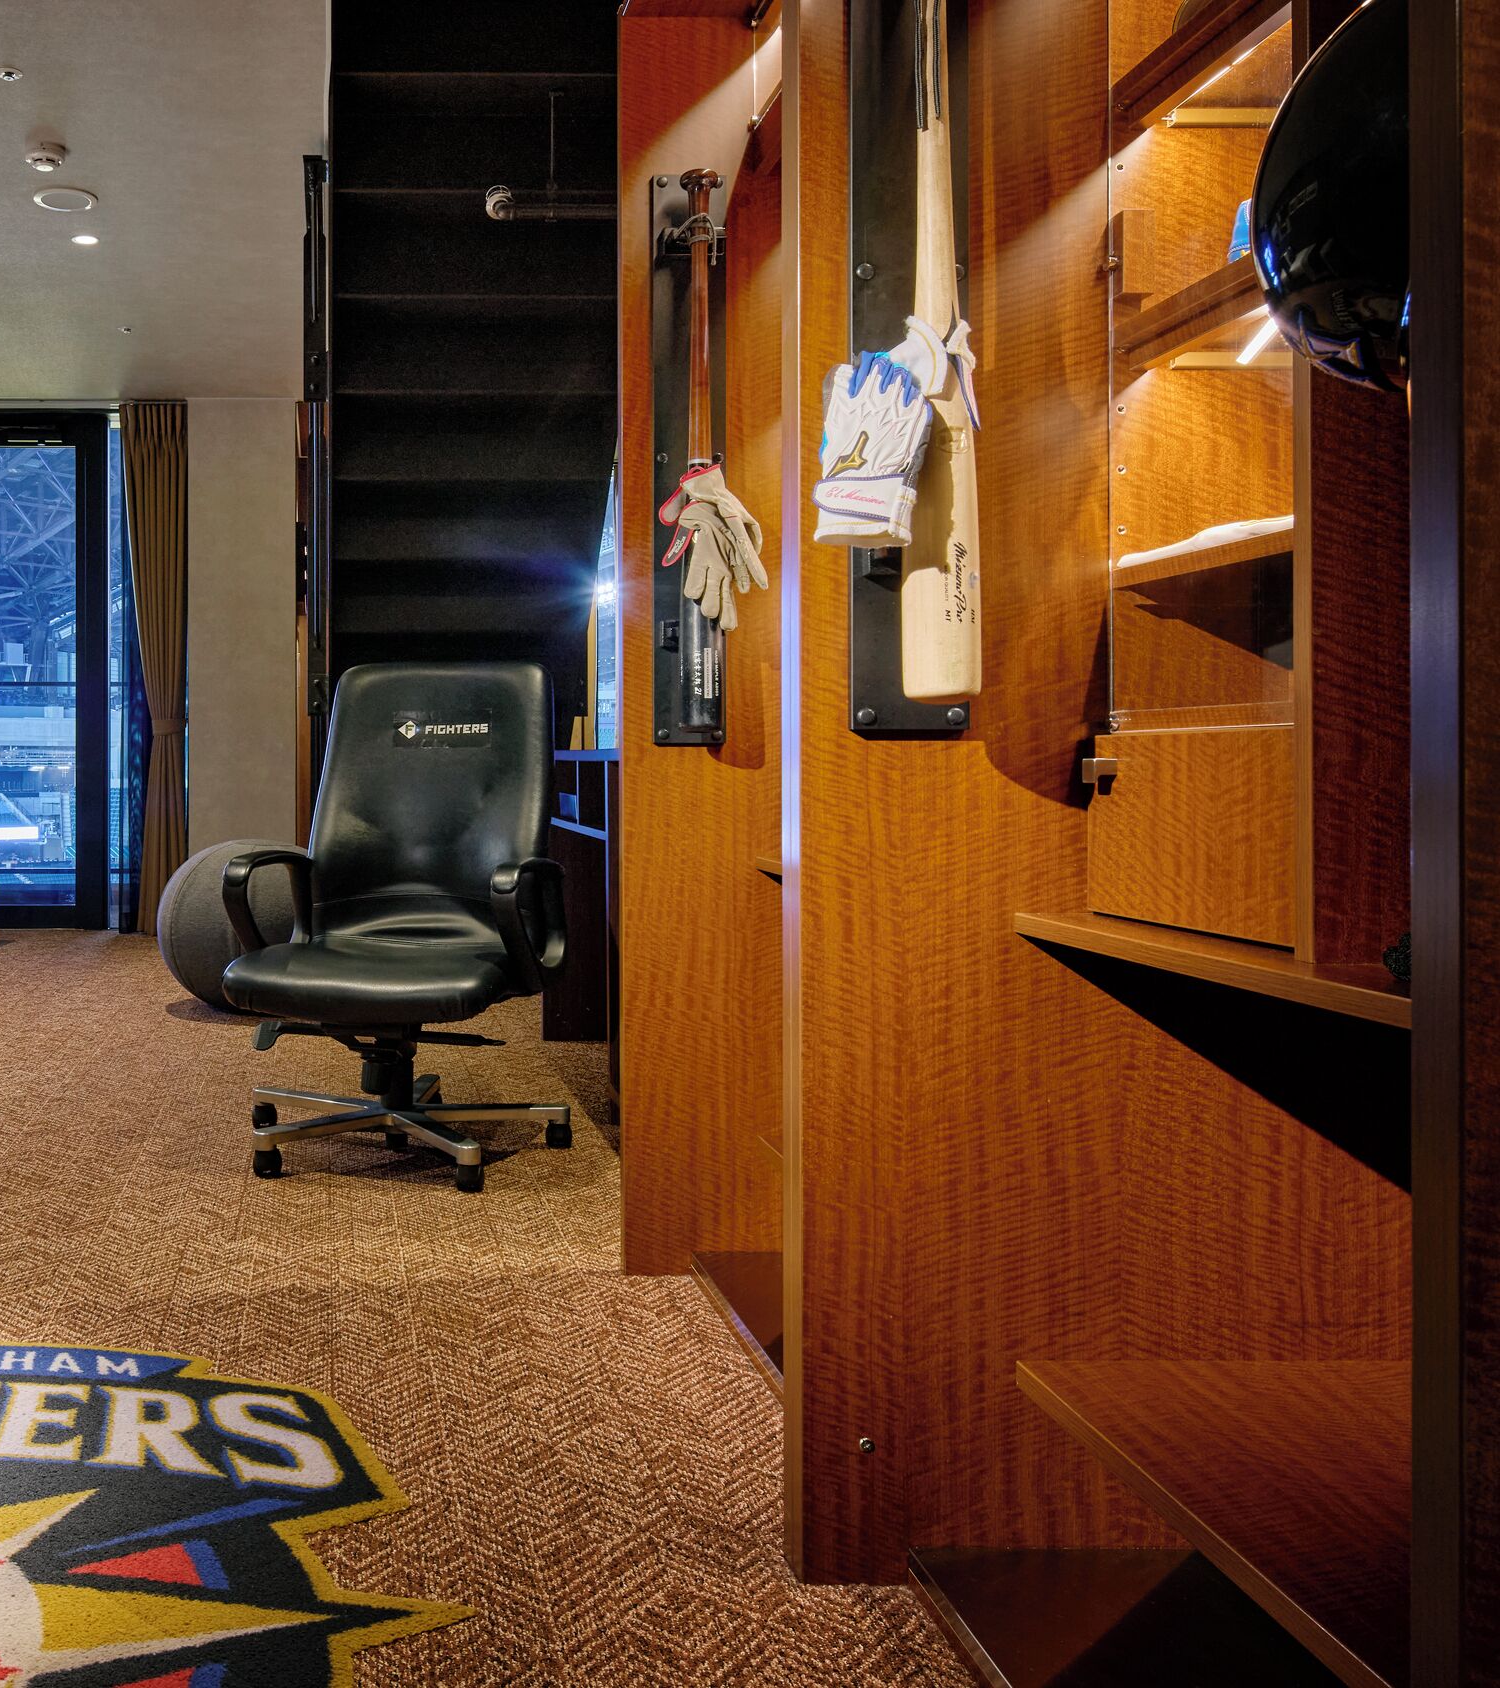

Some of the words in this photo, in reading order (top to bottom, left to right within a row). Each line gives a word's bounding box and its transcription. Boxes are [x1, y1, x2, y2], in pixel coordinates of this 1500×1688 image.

[953, 541, 968, 595] Mizuno
[954, 593, 967, 624] Pro
[425, 723, 489, 734] FIGHTERS
